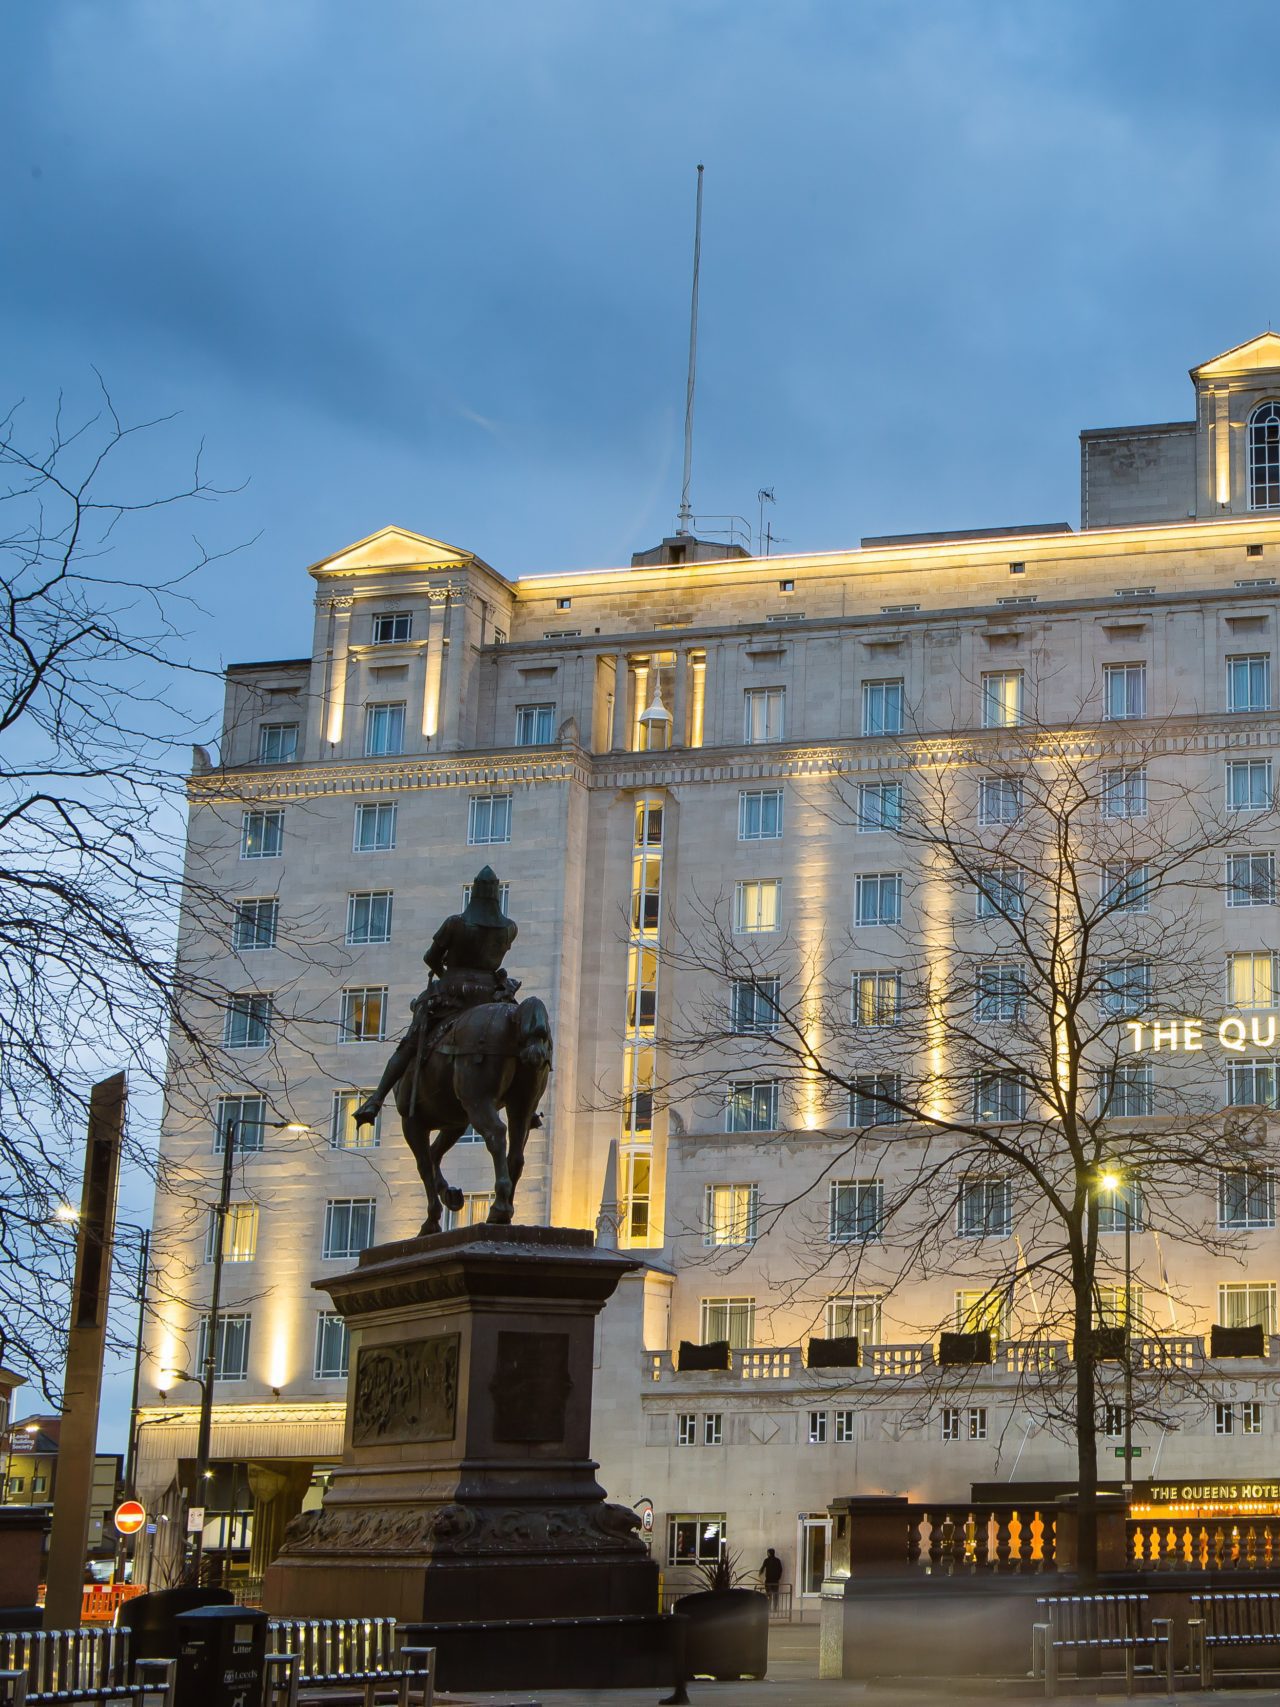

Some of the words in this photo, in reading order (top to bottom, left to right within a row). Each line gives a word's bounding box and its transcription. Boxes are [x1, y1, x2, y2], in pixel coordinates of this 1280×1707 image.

[1127, 1020, 1204, 1052] THE
[1151, 1487, 1178, 1500] THE
[1181, 1486, 1238, 1500] QUEENS
[232, 1646, 252, 1654] Litter
[235, 1670, 258, 1680] Leeds
